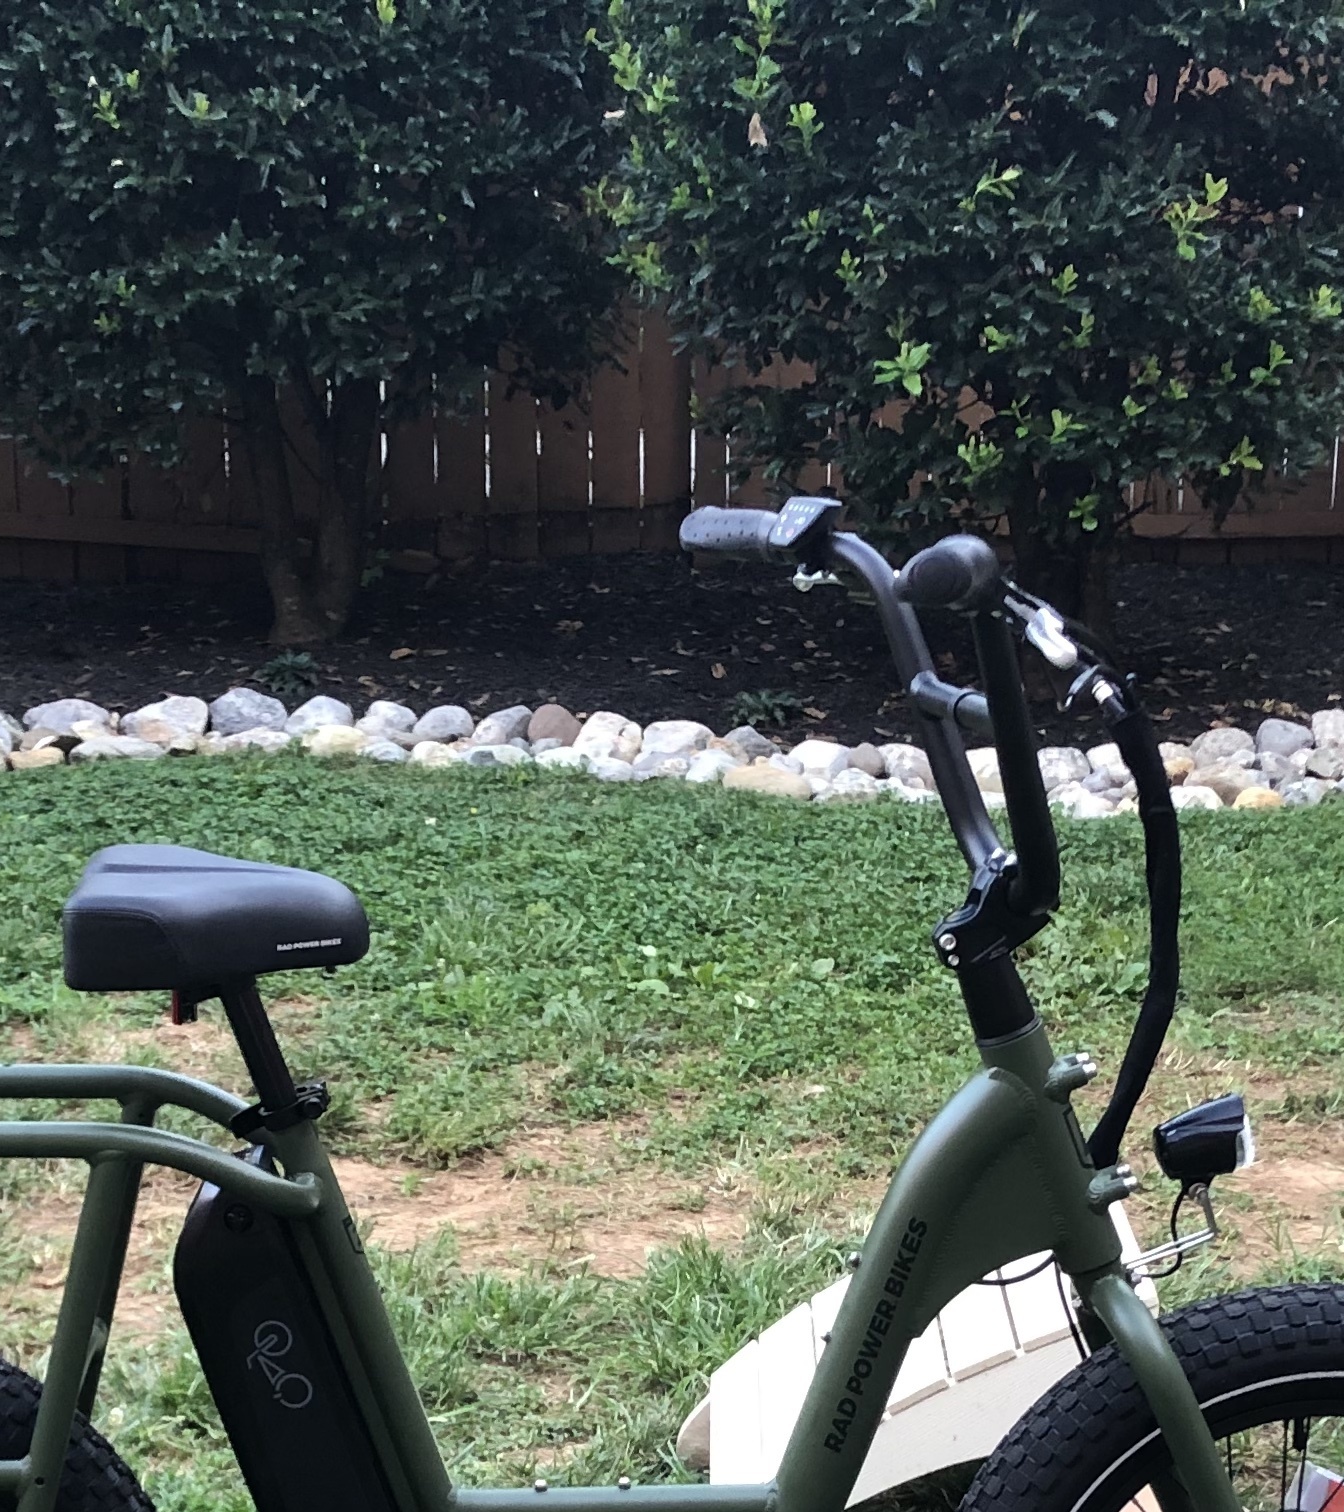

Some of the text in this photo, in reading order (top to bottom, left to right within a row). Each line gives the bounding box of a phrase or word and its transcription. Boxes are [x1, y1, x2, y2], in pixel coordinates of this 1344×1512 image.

[293, 941, 319, 949] POWER
[823, 1216, 928, 1454] RAD POWER BIKES
